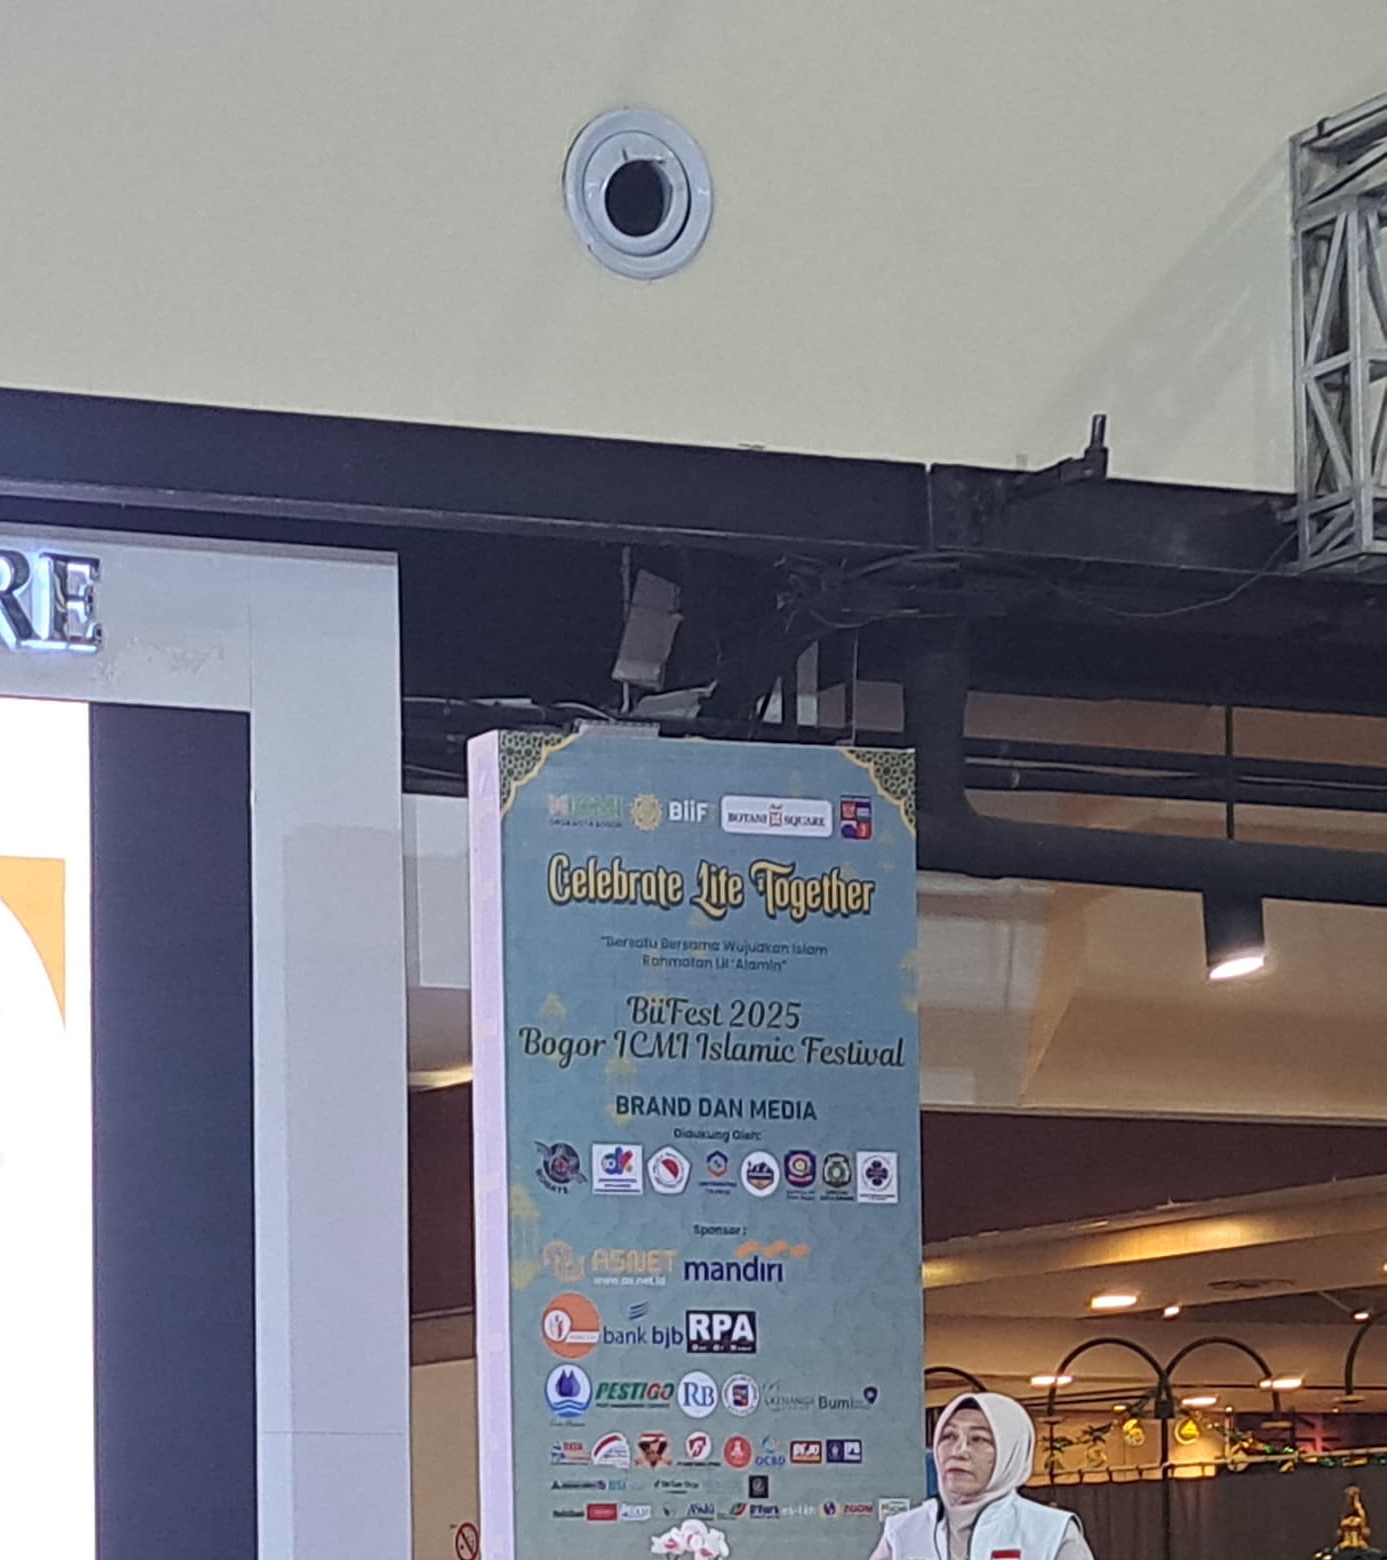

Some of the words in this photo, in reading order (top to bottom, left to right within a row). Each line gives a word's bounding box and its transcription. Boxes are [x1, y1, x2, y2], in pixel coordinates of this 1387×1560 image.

[727, 811, 768, 828] BOTANI
[784, 812, 827, 829] SQUARE
[547, 853, 684, 907] Celebrate
[690, 858, 744, 919] Life
[749, 858, 875, 923] Together
[660, 937, 720, 953] Bersama
[723, 938, 789, 957] Wujudkan
[730, 999, 802, 1031] 2025
[518, 1026, 606, 1069] Bogor
[613, 1030, 690, 1061] ICMI
[696, 1032, 796, 1065] Islamic
[800, 1036, 907, 1069] Festival
[615, 1094, 693, 1119] BRAND
[698, 1096, 746, 1120] DAN
[750, 1098, 818, 1121] MEDIA
[683, 1256, 785, 1284] mandiri
[603, 1326, 647, 1346] bank
[651, 1326, 685, 1349] bjb
[687, 1313, 756, 1342] RPA
[595, 1381, 676, 1401] PESTIGO
[683, 1381, 716, 1408] RB
